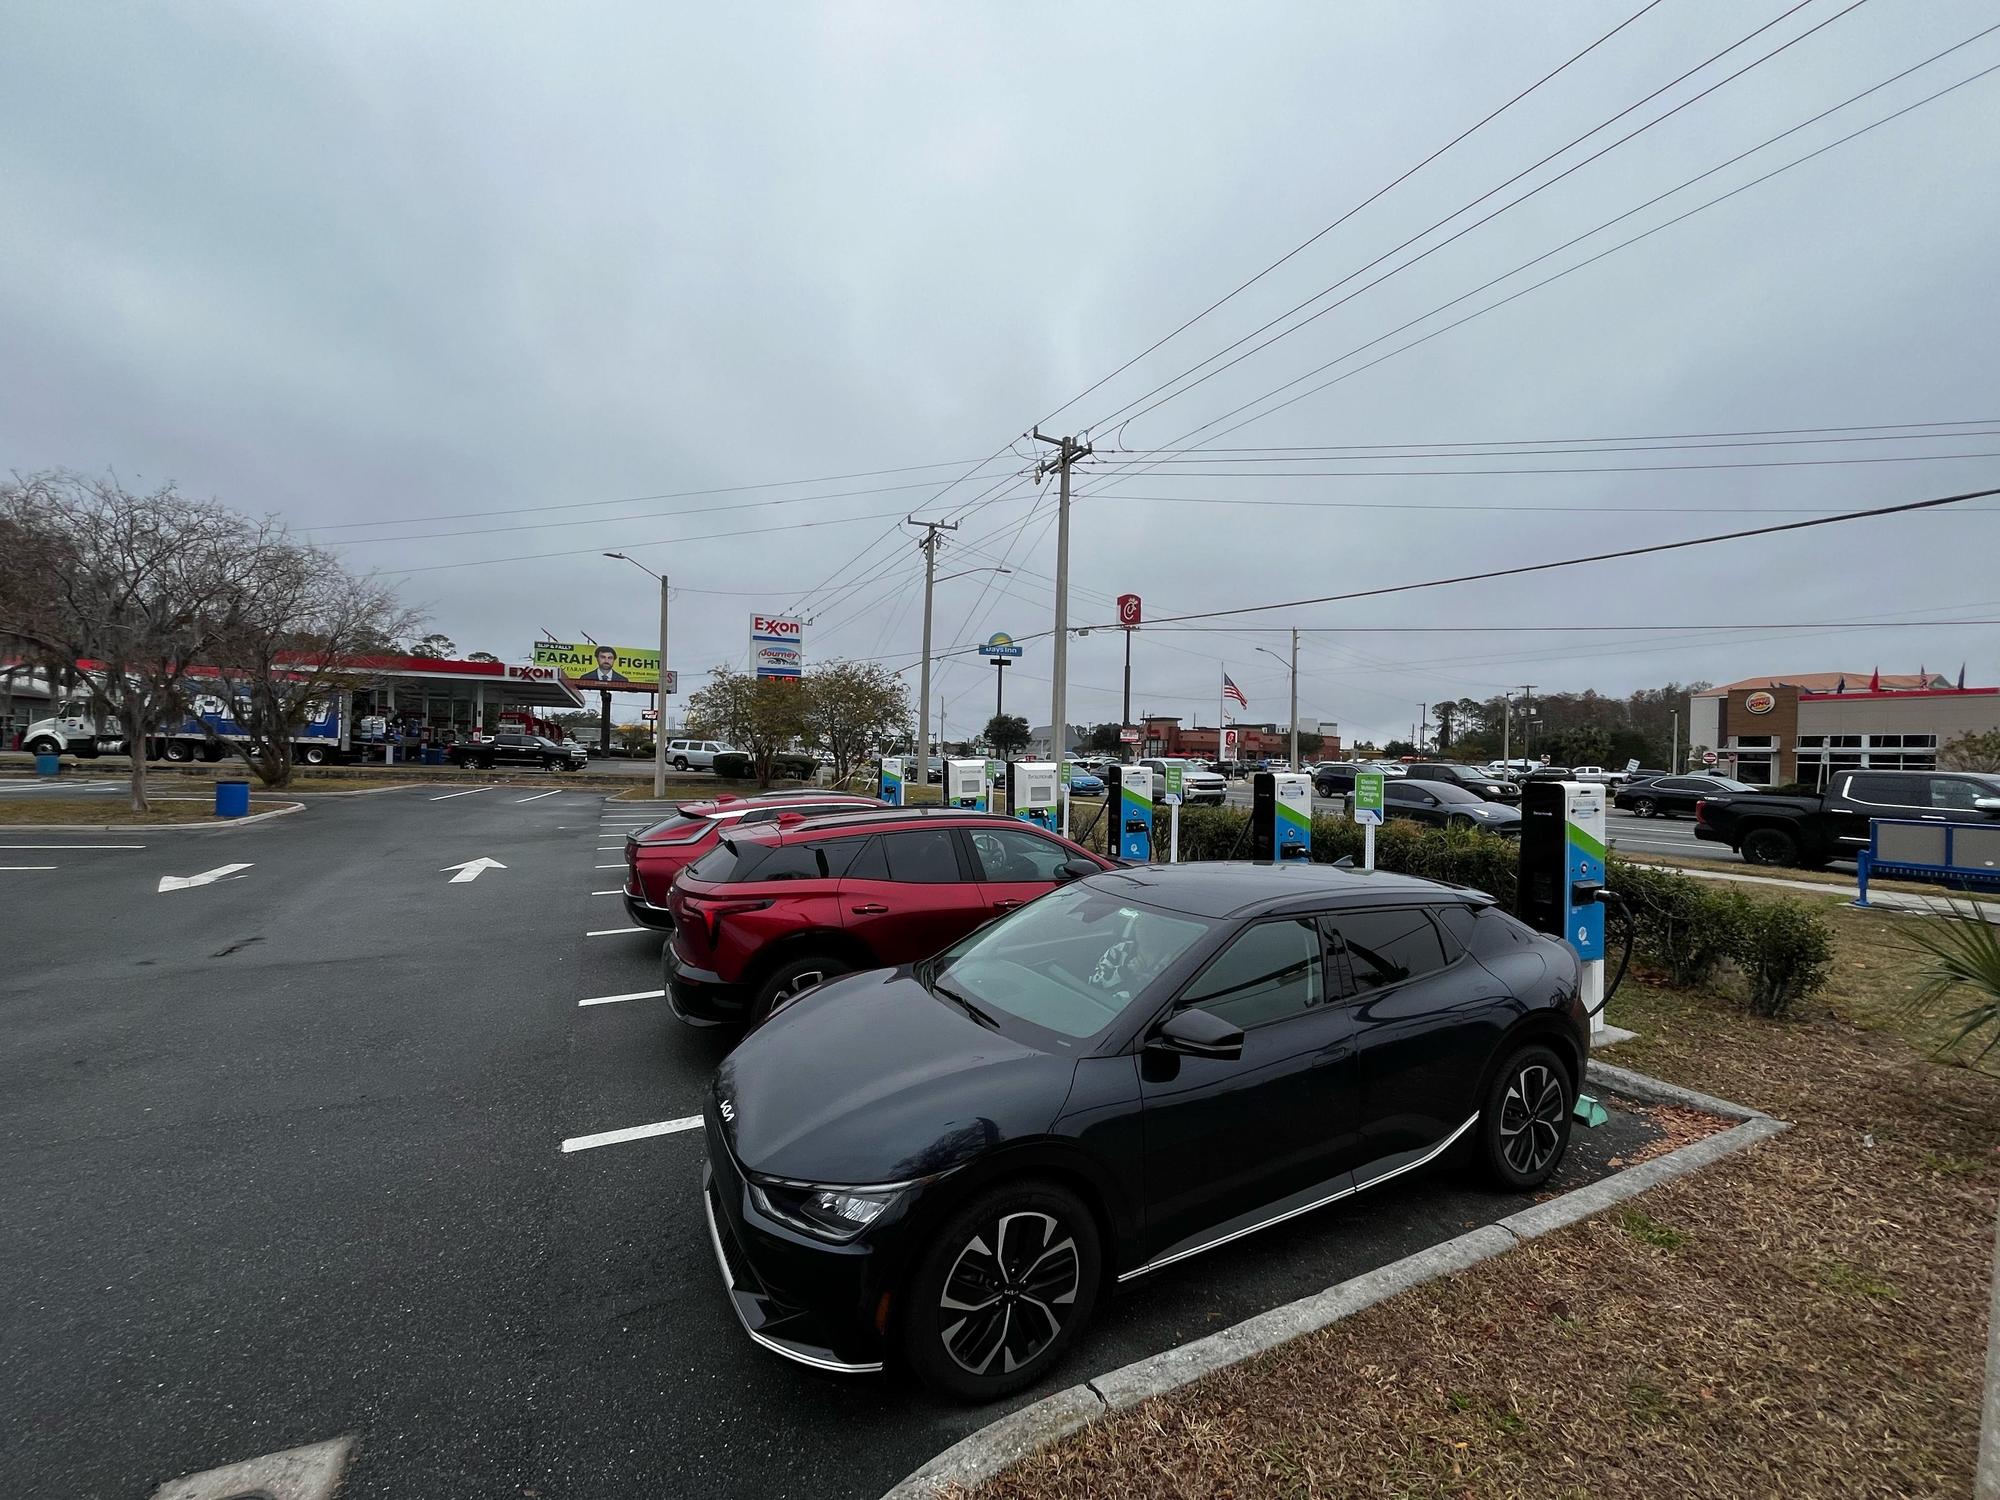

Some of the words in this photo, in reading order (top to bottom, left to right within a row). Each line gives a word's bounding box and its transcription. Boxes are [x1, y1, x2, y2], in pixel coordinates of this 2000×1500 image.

[755, 617, 799, 636] Exxon
[537, 651, 593, 665] FARAH
[761, 649, 798, 660] Journey
[509, 666, 554, 682] EXXON
